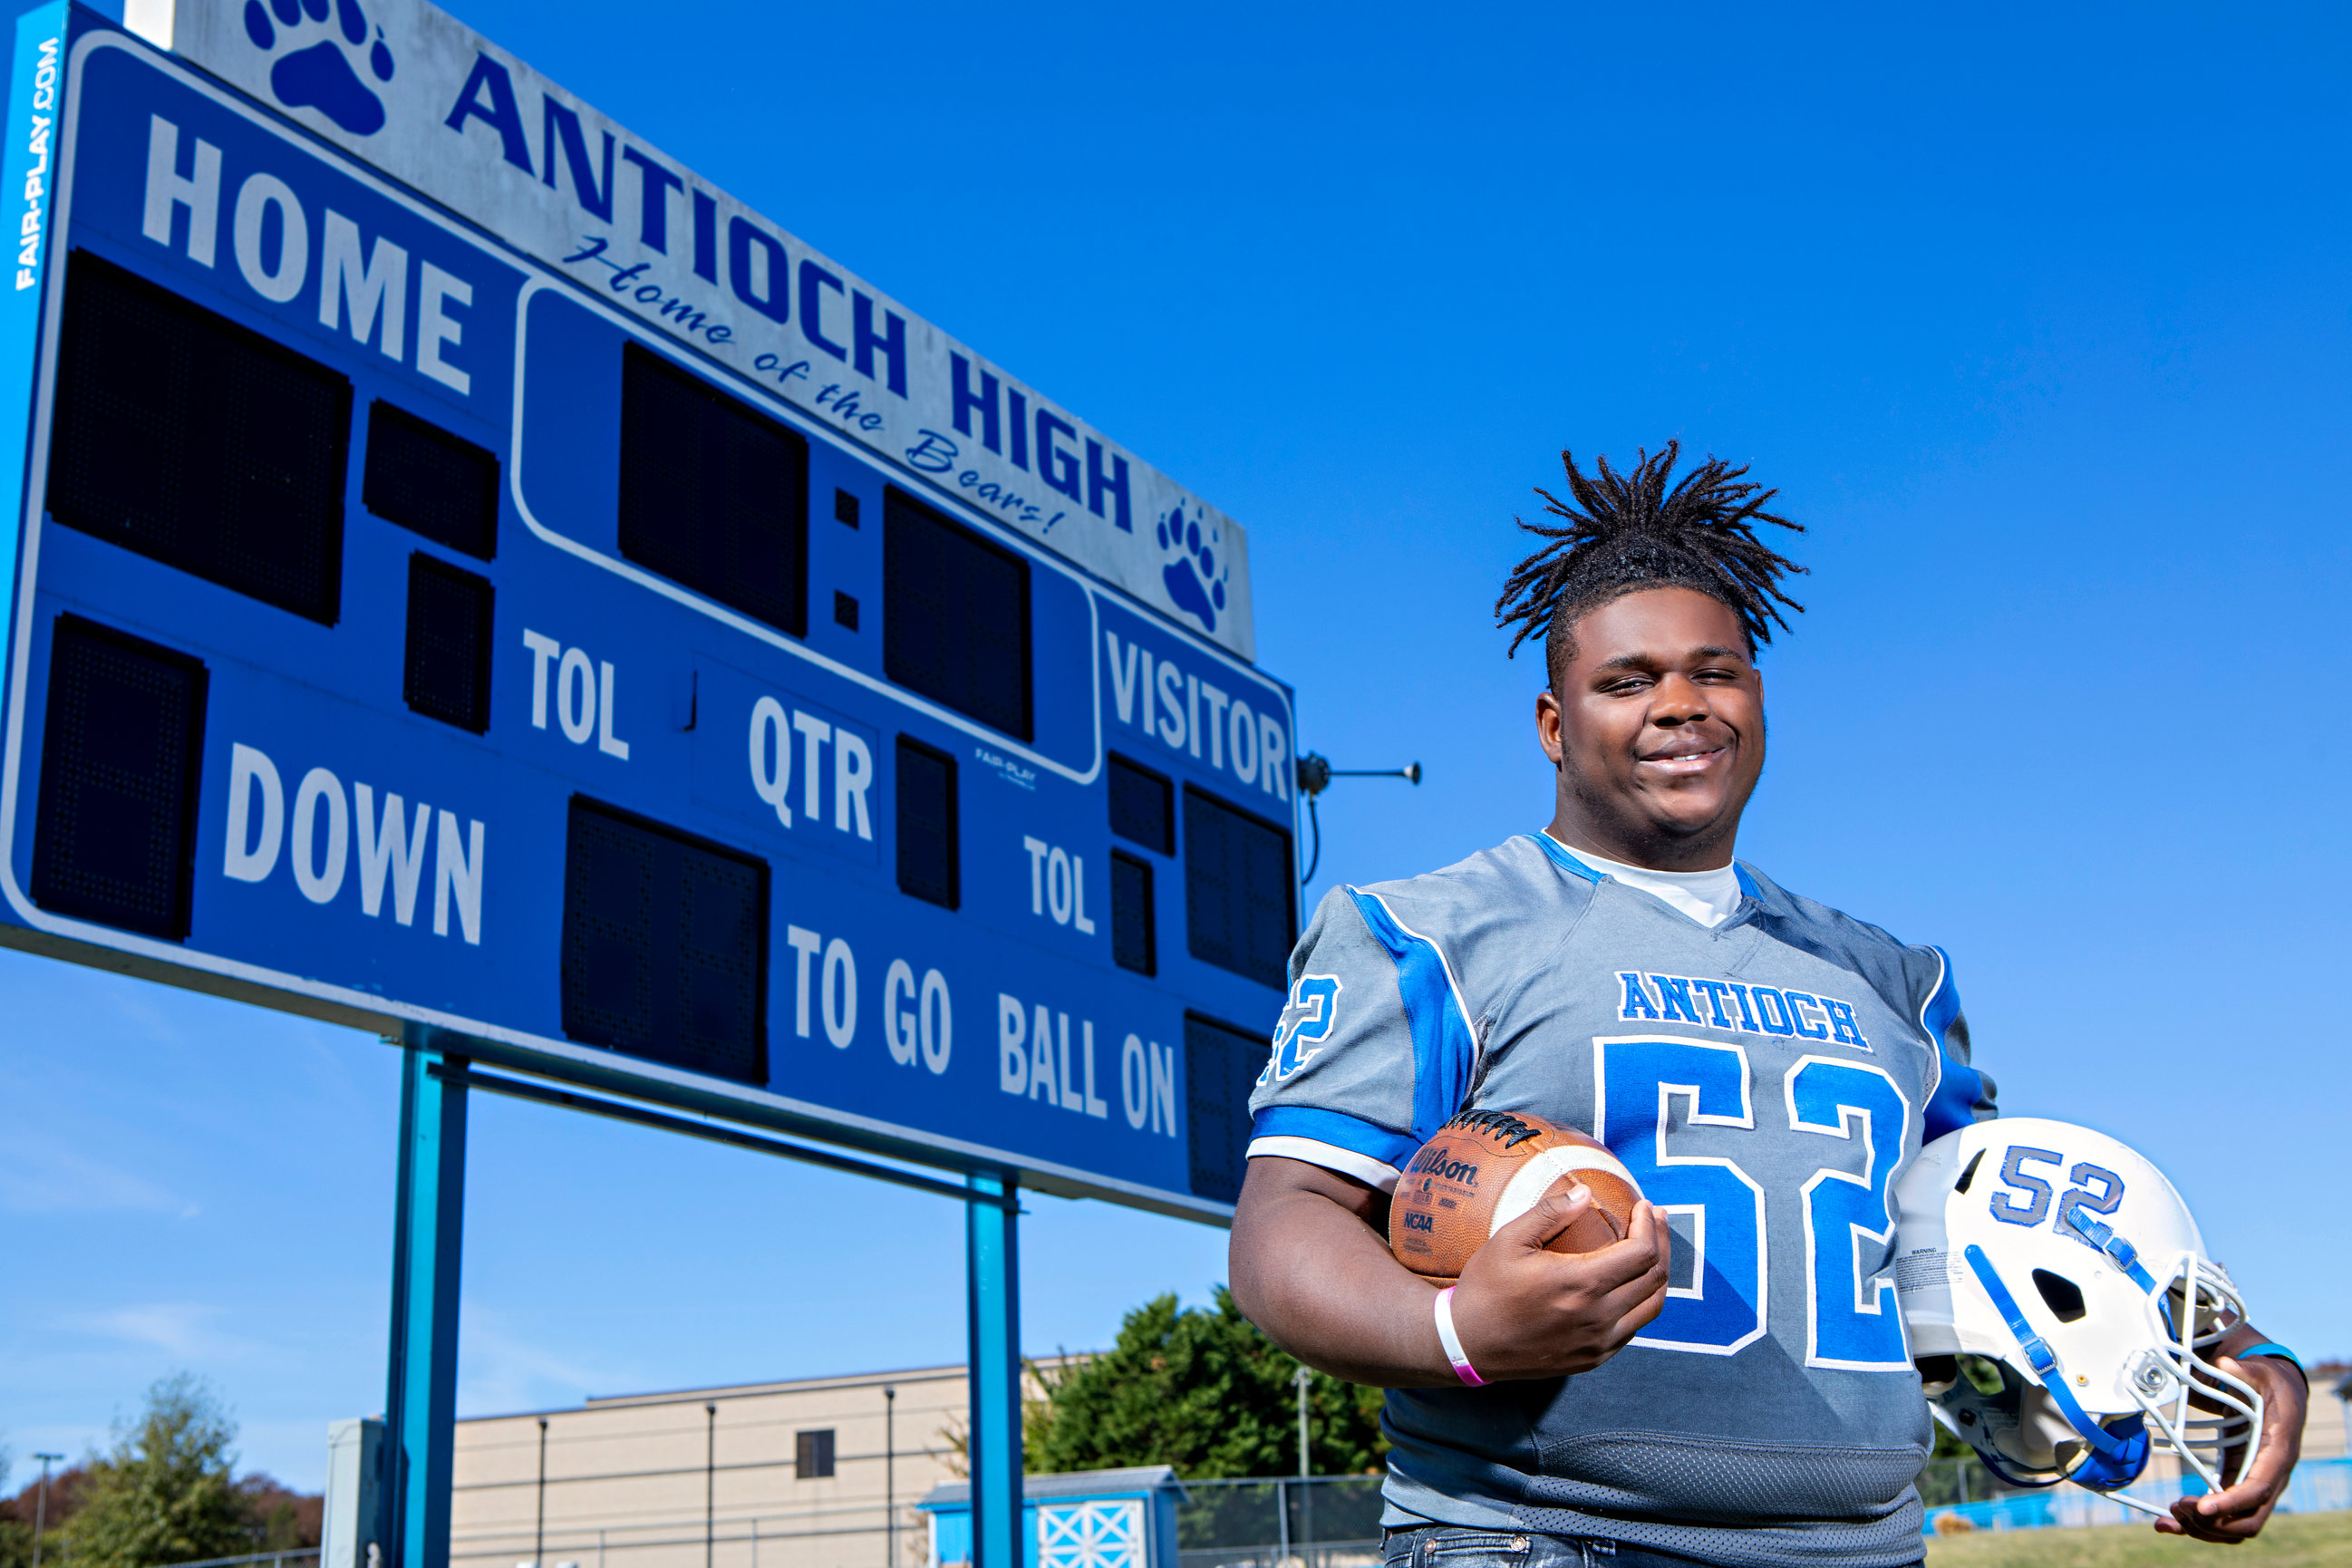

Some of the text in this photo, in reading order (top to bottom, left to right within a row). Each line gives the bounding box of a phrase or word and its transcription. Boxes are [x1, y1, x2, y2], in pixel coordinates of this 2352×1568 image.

[15, 36, 60, 292] FAIR-PLAY.COM
[141, 112, 474, 397] HOME
[444, 50, 1134, 535] ANTIOCH HIGH
[563, 235, 1066, 536] Home of the Bears!
[523, 628, 630, 760] TOL
[1106, 631, 1291, 802] VISITOR
[749, 695, 873, 841] QTR
[223, 741, 485, 946] DOWN
[1023, 835, 1095, 935] TOL
[788, 924, 953, 1076] TO GO
[999, 992, 1176, 1137] BALL ON
[1614, 971, 1873, 1052] ANTIOCH
[1403, 1212, 1433, 1233] NCAA
[1410, 1148, 1478, 1186] Wilson
[1592, 1034, 1915, 1372] 52
[1989, 1145, 2125, 1255] 52
[1912, 1247, 1937, 1255] WARNING
